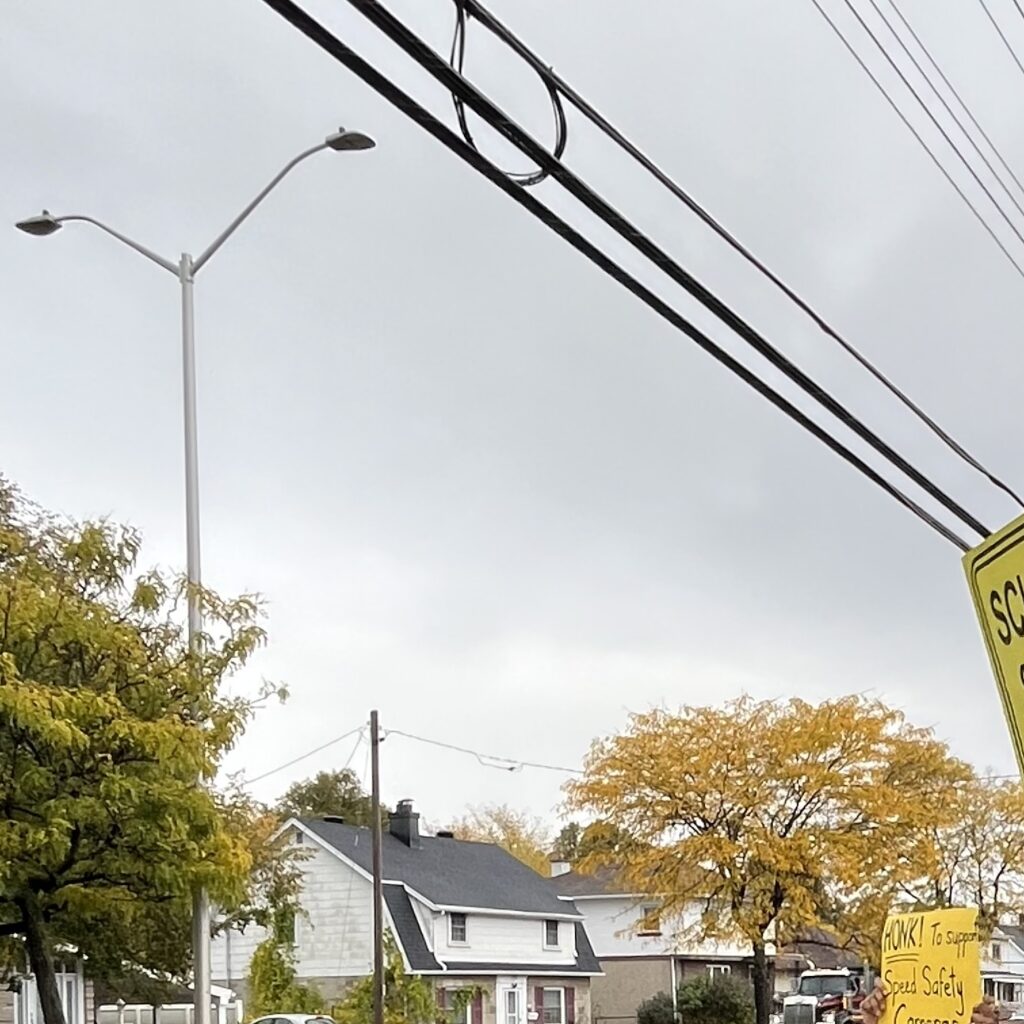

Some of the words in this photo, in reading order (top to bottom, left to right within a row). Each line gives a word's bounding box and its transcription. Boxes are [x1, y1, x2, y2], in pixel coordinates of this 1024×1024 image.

[883, 915, 925, 953] HONK!
[931, 922, 943, 947] To
[884, 966, 917, 1007] Speed
[922, 965, 965, 1016] Safety
